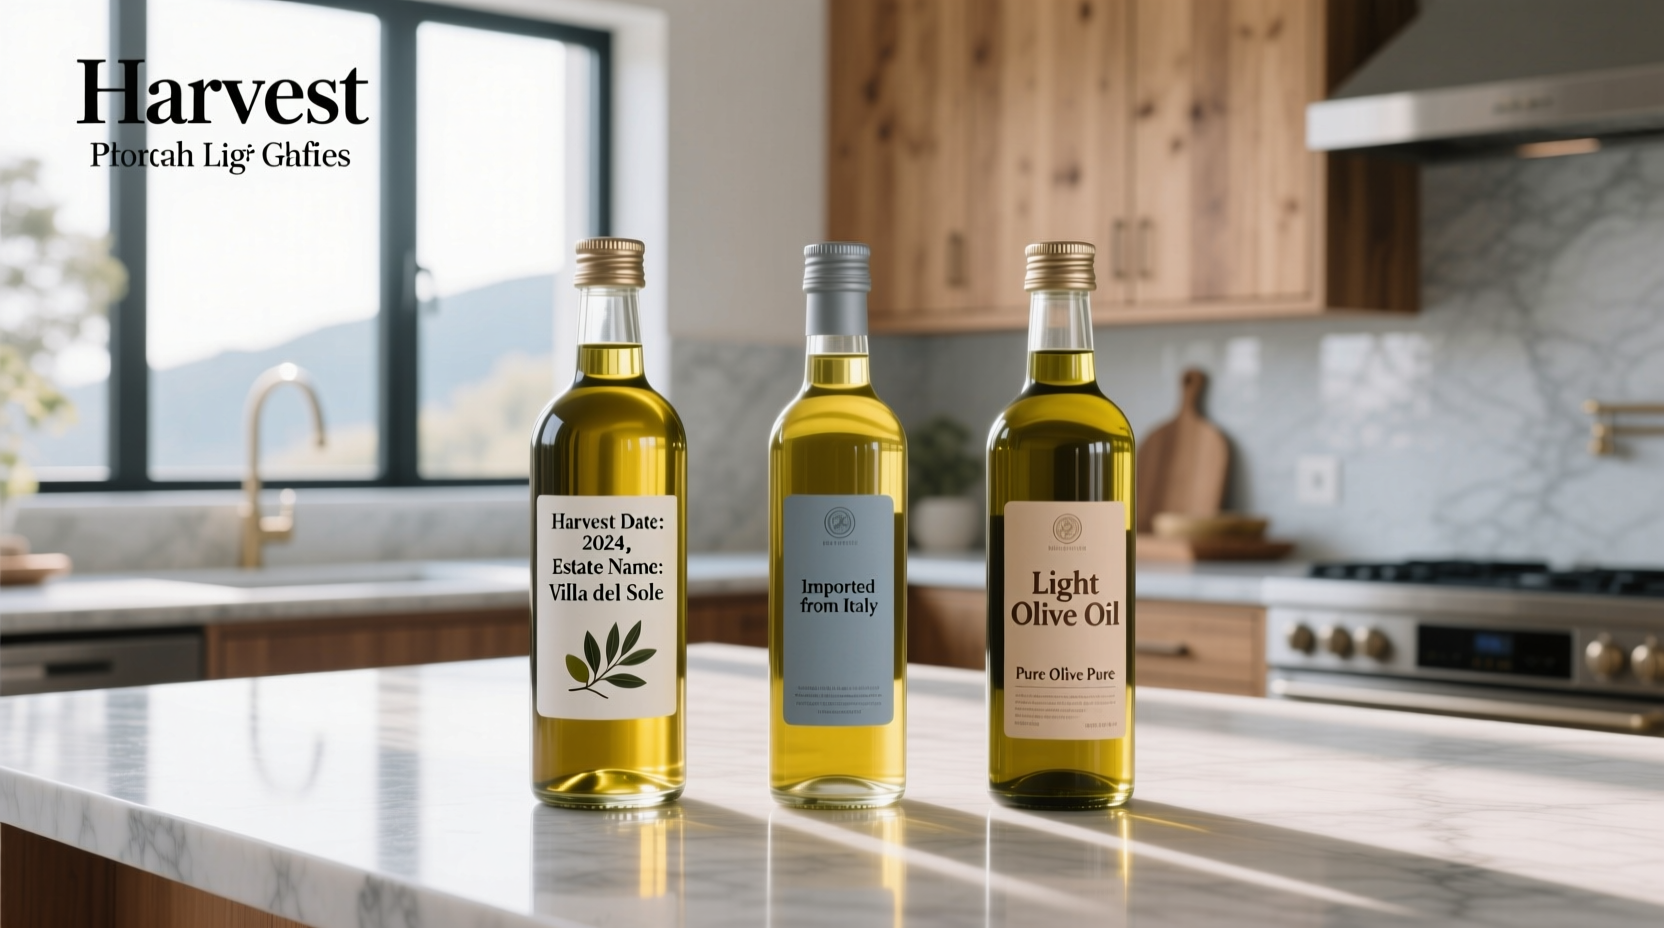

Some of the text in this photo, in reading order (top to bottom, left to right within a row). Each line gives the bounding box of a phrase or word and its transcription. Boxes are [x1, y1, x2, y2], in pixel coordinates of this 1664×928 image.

[551, 512, 664, 530] Harvest Date:
[582, 534, 631, 554] 2024,
[552, 558, 663, 575] Estate Name:
[549, 582, 664, 601] Villa del Sole
[801, 579, 875, 598] Imported
[1032, 569, 1100, 603] Light
[800, 596, 878, 617] from Italy
[1011, 600, 1120, 627] Olive Oil
[1016, 666, 1116, 681] Pure Olive Pure
